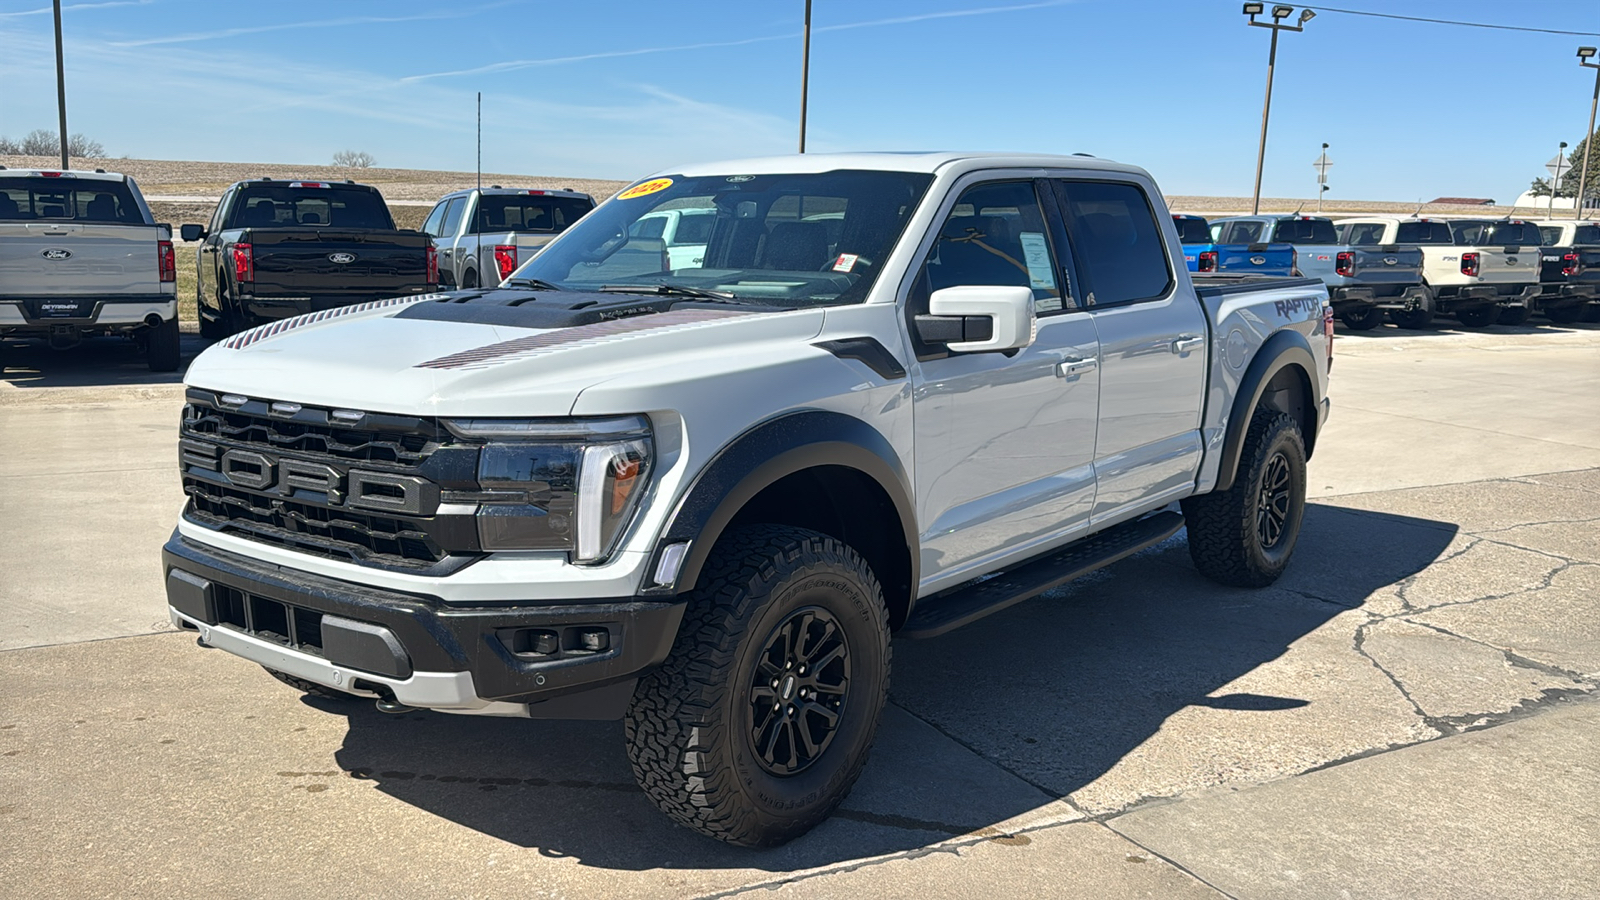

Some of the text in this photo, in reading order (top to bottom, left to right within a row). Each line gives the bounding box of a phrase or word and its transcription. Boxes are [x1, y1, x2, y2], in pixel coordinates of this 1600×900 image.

[621, 181, 669, 197] 2026
[45, 249, 69, 259] Ford
[331, 254, 353, 263] Ford
[1274, 297, 1322, 321] RAPTOR
[179, 439, 441, 516] FORD
